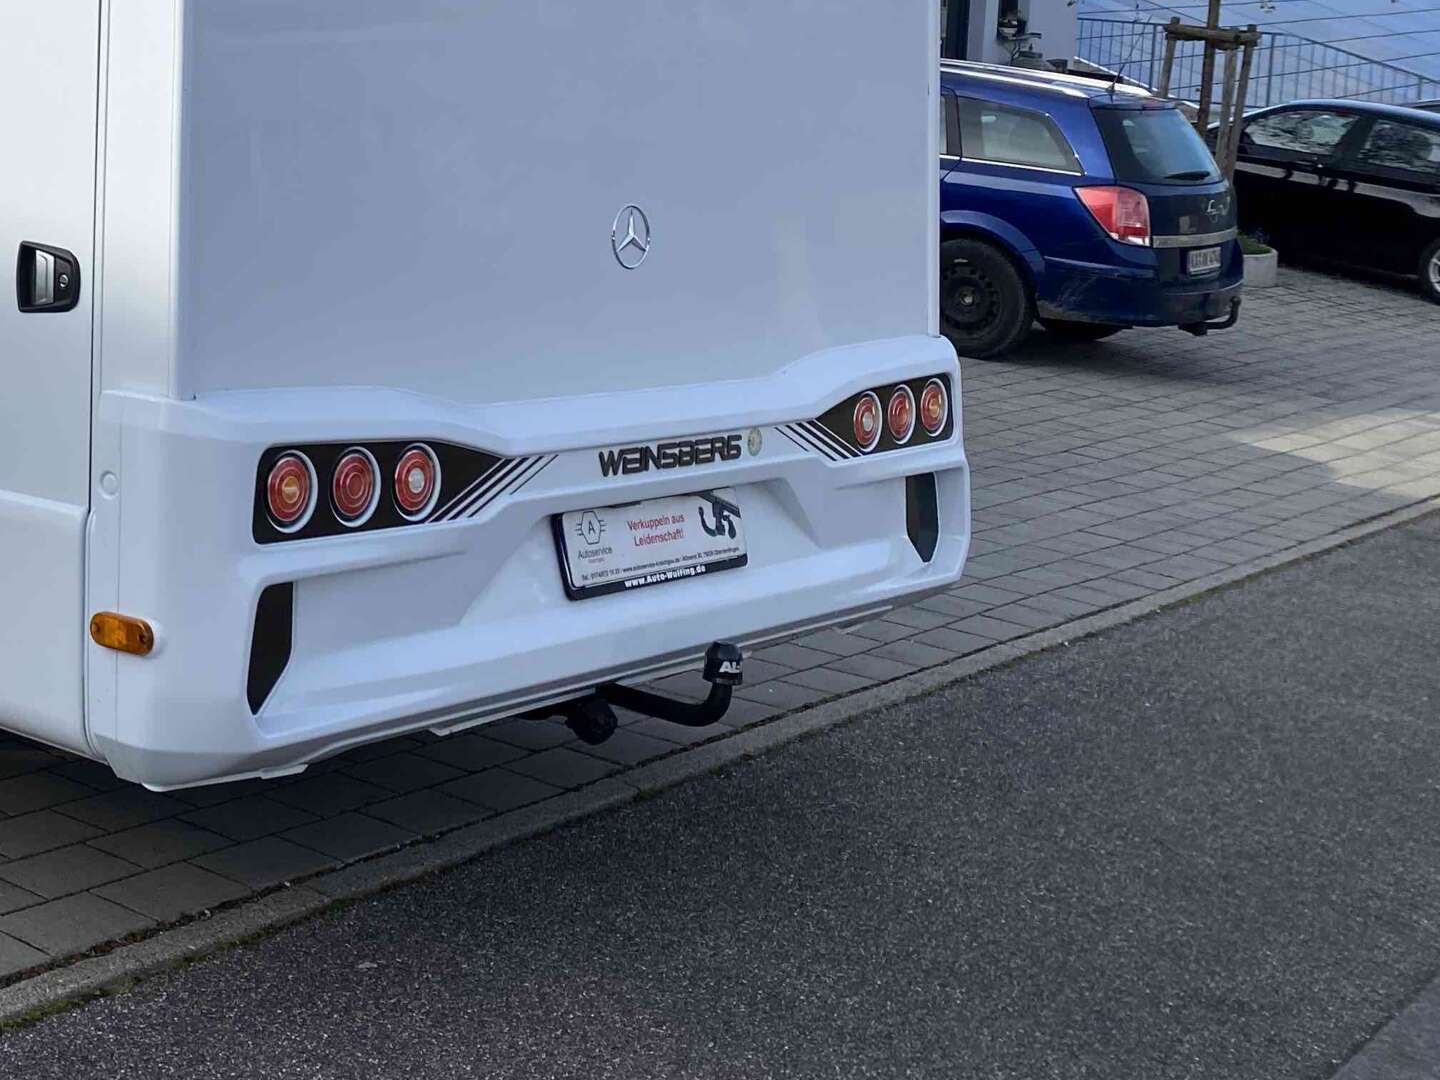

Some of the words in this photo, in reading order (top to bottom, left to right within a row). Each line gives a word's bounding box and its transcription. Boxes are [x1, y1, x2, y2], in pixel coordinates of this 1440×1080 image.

[598, 434, 743, 478] WEINSBERG
[626, 514, 671, 532] Verkuppeln
[671, 513, 686, 524] aus
[633, 528, 685, 547] Leidenschaft!
[577, 546, 613, 561] Autoservice
